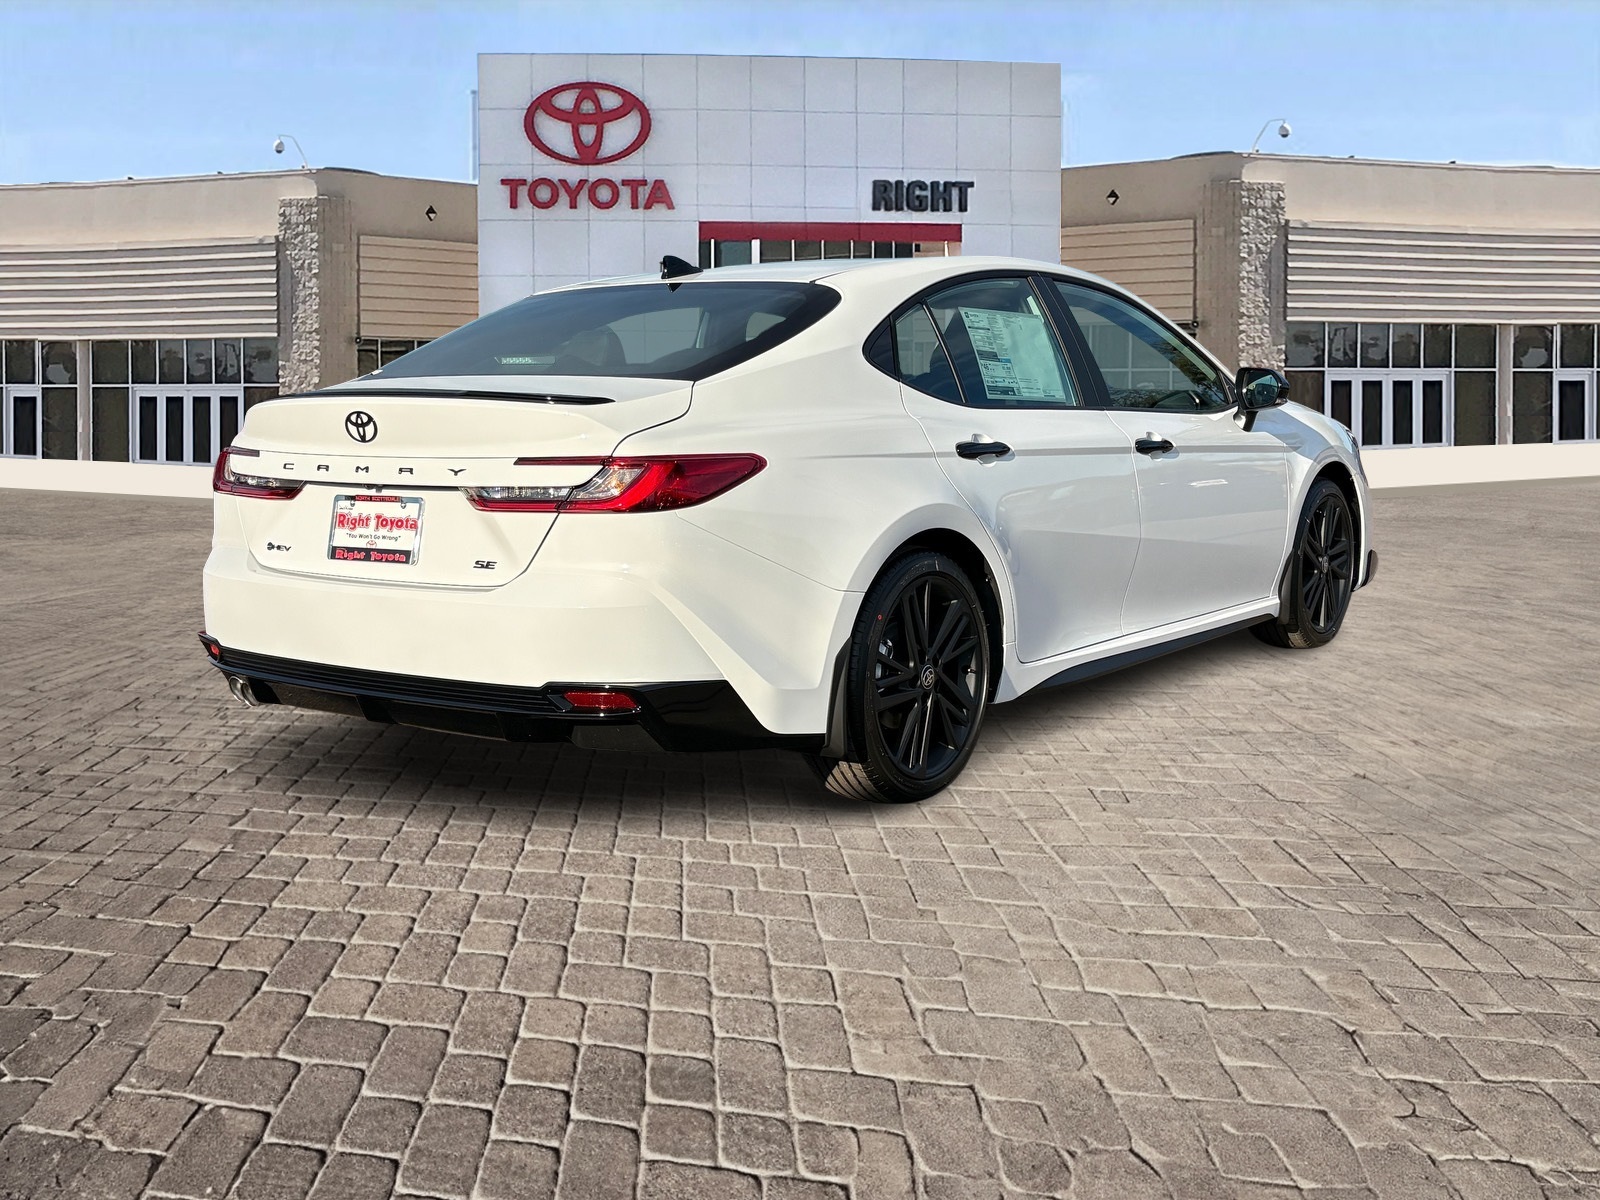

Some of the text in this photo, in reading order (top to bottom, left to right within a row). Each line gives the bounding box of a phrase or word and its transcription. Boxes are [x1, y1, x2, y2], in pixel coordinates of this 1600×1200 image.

[500, 177, 676, 210] TOYOTA
[871, 179, 975, 213] RIGHT
[283, 462, 467, 476] CAMRY
[336, 512, 419, 532] Right Toyota
[335, 548, 406, 562] Right Toyota
[472, 560, 498, 570] SE
